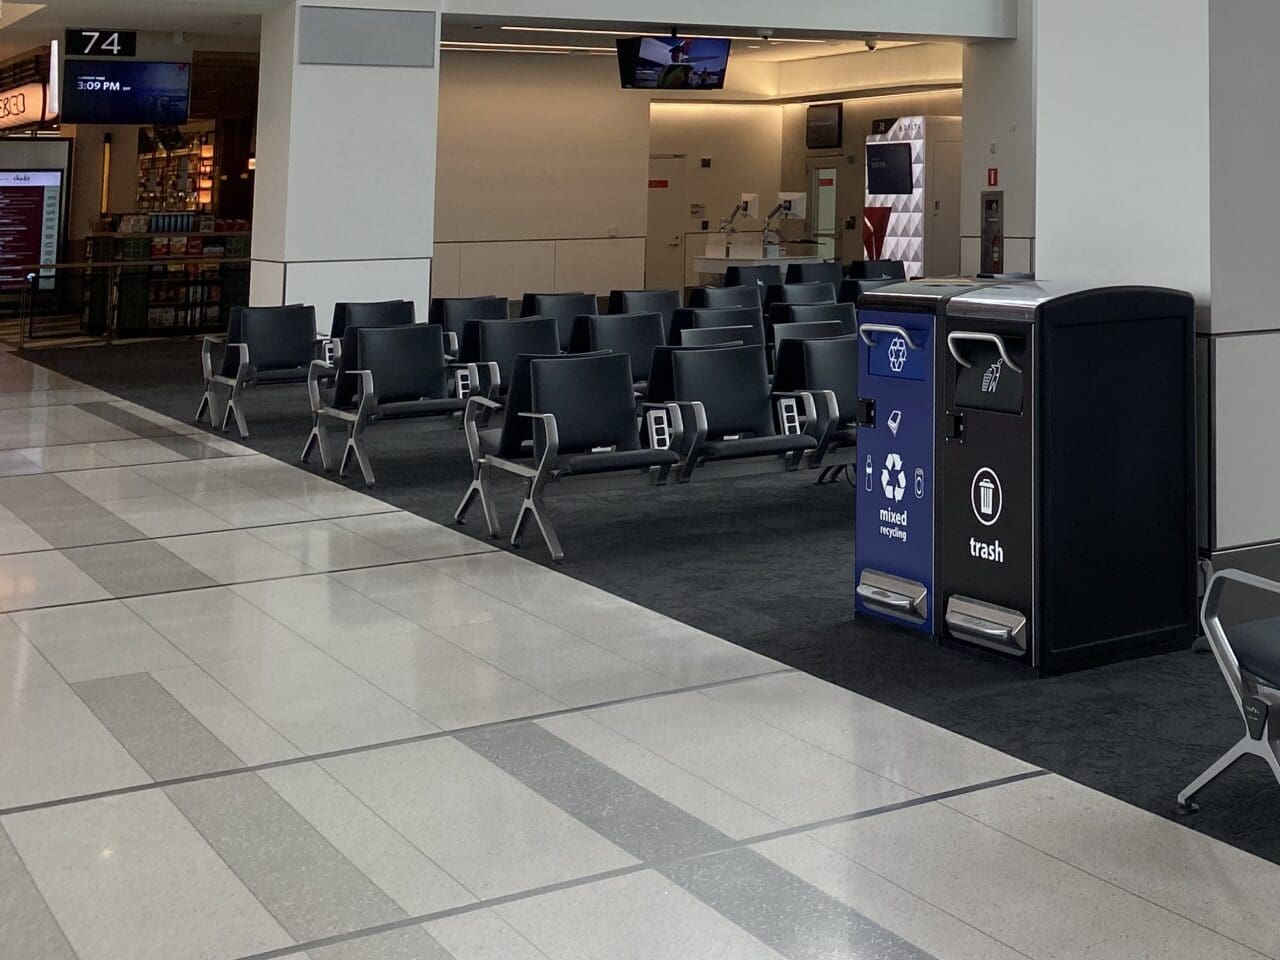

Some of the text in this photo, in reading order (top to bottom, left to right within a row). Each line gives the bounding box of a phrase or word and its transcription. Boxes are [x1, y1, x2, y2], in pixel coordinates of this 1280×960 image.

[82, 32, 122, 54] 74
[77, 81, 101, 90] 3:09
[103, 81, 120, 91] PM
[904, 123, 921, 131] DELTA
[879, 507, 907, 526] mixed
[880, 526, 907, 542] recycling
[970, 537, 1004, 563] trash
